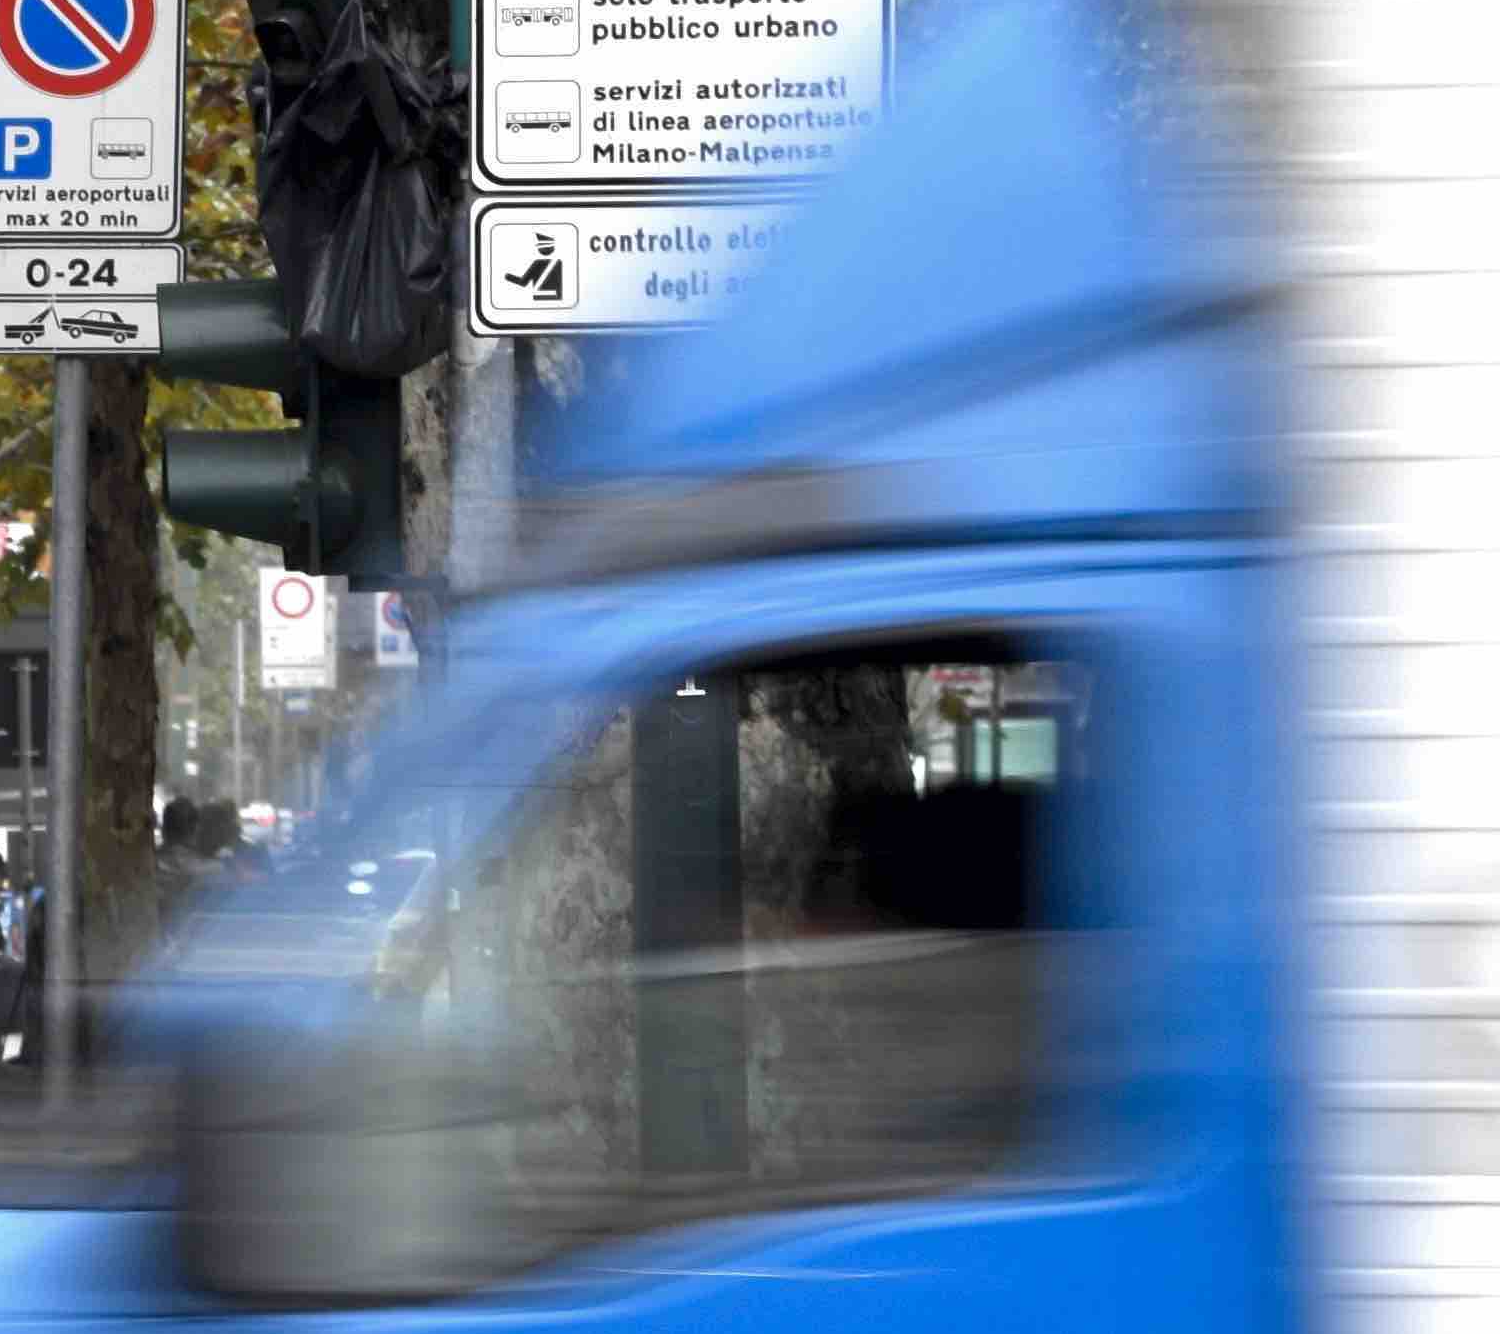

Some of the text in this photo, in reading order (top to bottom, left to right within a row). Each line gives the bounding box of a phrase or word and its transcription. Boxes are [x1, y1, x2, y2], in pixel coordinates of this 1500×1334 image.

[592, 13, 838, 45] pubblico urbano
[593, 75, 848, 102] servizi autorizzati
[592, 111, 615, 132] di
[628, 110, 690, 131] linea
[4, 126, 39, 172] P
[592, 141, 833, 167] Milano-Malpensa
[45, 184, 169, 205] aeroportuali
[6, 211, 138, 228] max 20 min
[589, 224, 712, 254] controllo
[25, 258, 118, 288] 0-24
[644, 269, 709, 303] degli
